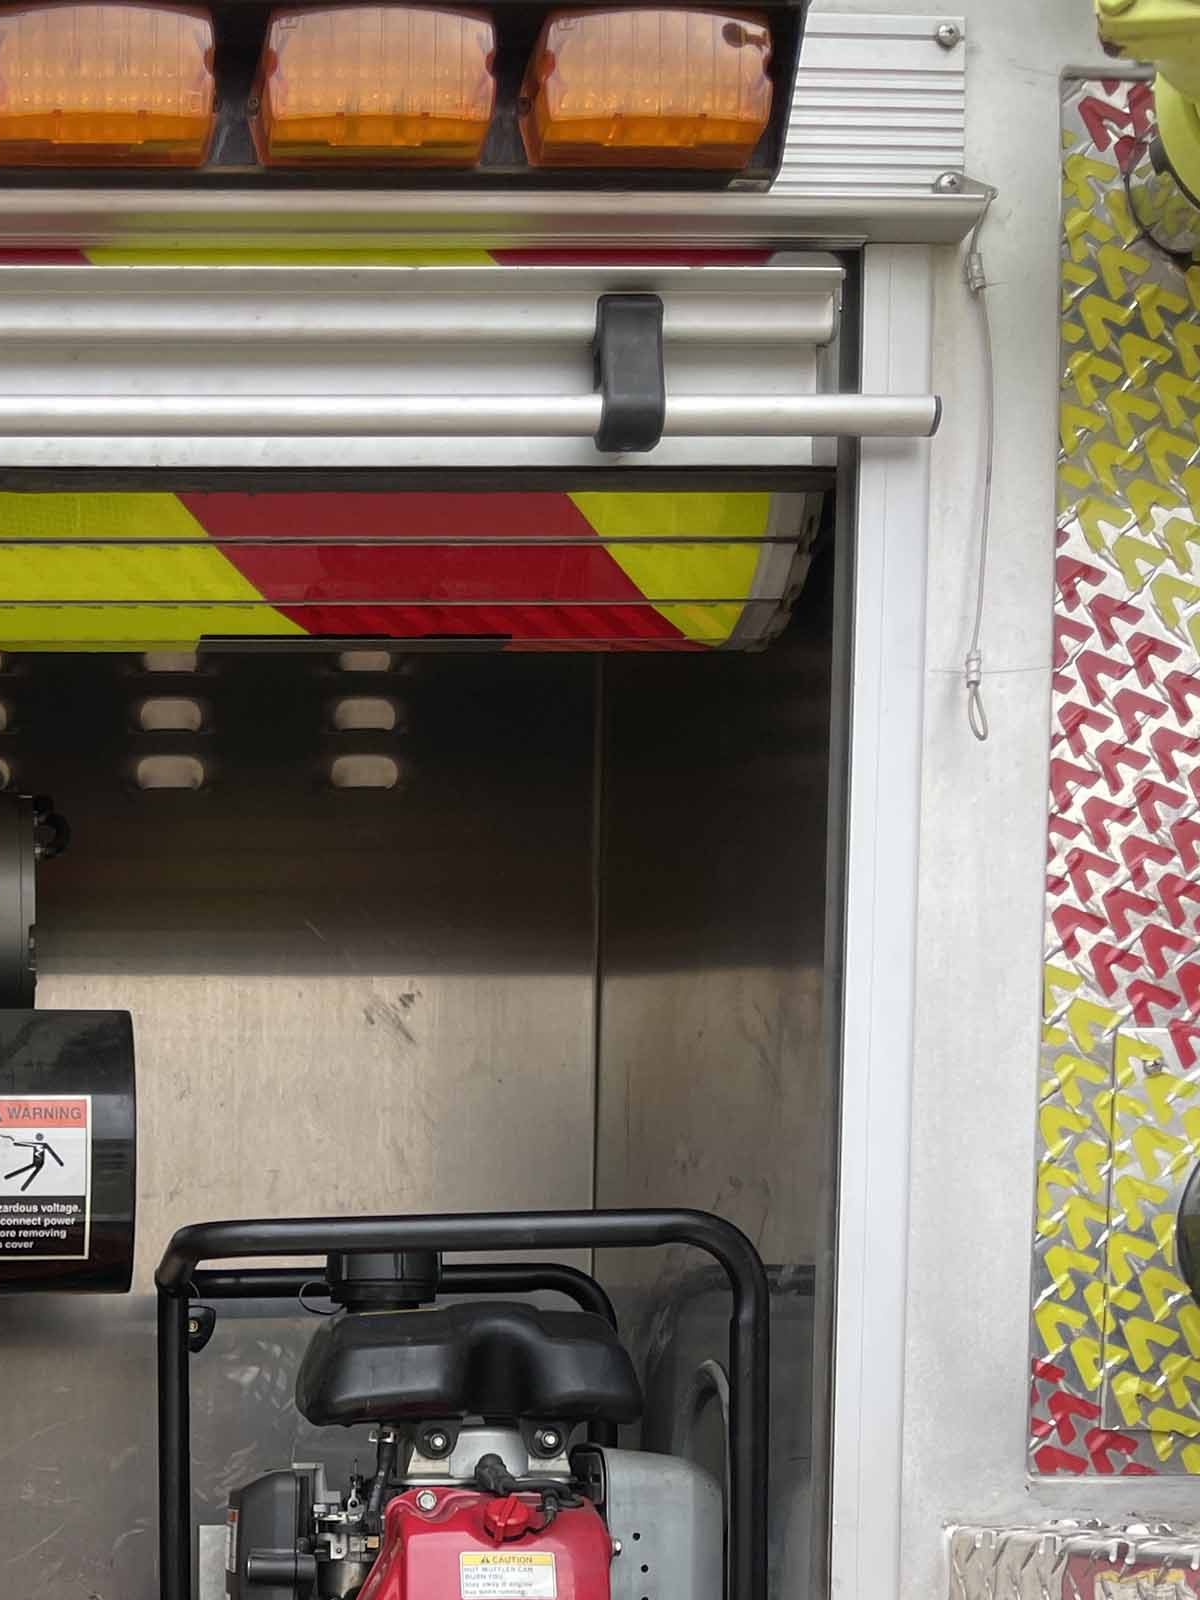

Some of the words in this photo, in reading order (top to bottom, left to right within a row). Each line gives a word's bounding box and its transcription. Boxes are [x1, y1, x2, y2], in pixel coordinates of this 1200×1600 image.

[7, 1107, 81, 1120] WARNING
[40, 1203, 81, 1215] voltage.
[44, 1217, 75, 1228] power
[18, 1228, 67, 1240] removing
[5, 1241, 34, 1249] cover
